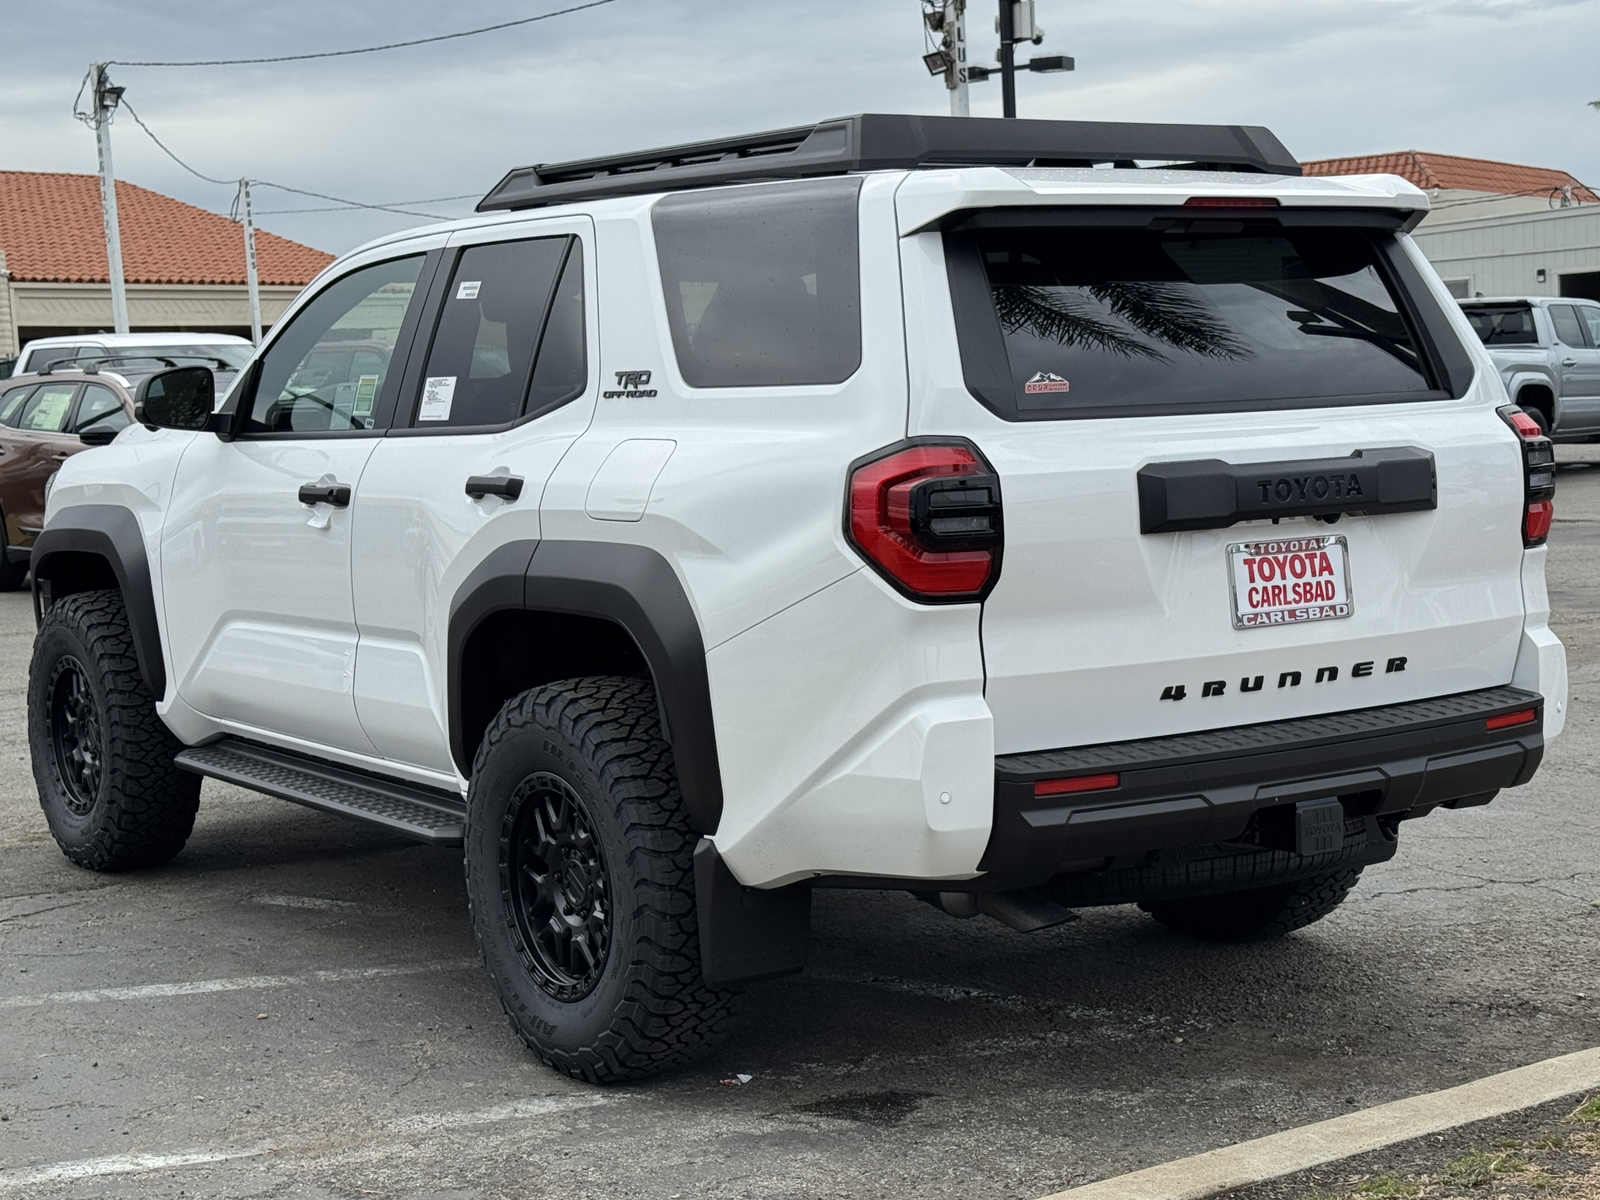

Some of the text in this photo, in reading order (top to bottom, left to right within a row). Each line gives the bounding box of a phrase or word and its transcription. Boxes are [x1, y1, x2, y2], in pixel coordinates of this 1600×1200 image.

[603, 389, 658, 399] OFF ROAD
[1256, 473, 1364, 505] TOYOTA
[1258, 538, 1319, 554] TOYOTA
[1242, 550, 1335, 583] TOYOTA
[1246, 577, 1336, 609] CARLSBAD
[1240, 604, 1348, 626] CARLSBAD
[1159, 656, 1408, 701] 4RUNNER
[1304, 822, 1342, 838] TOYOTA
